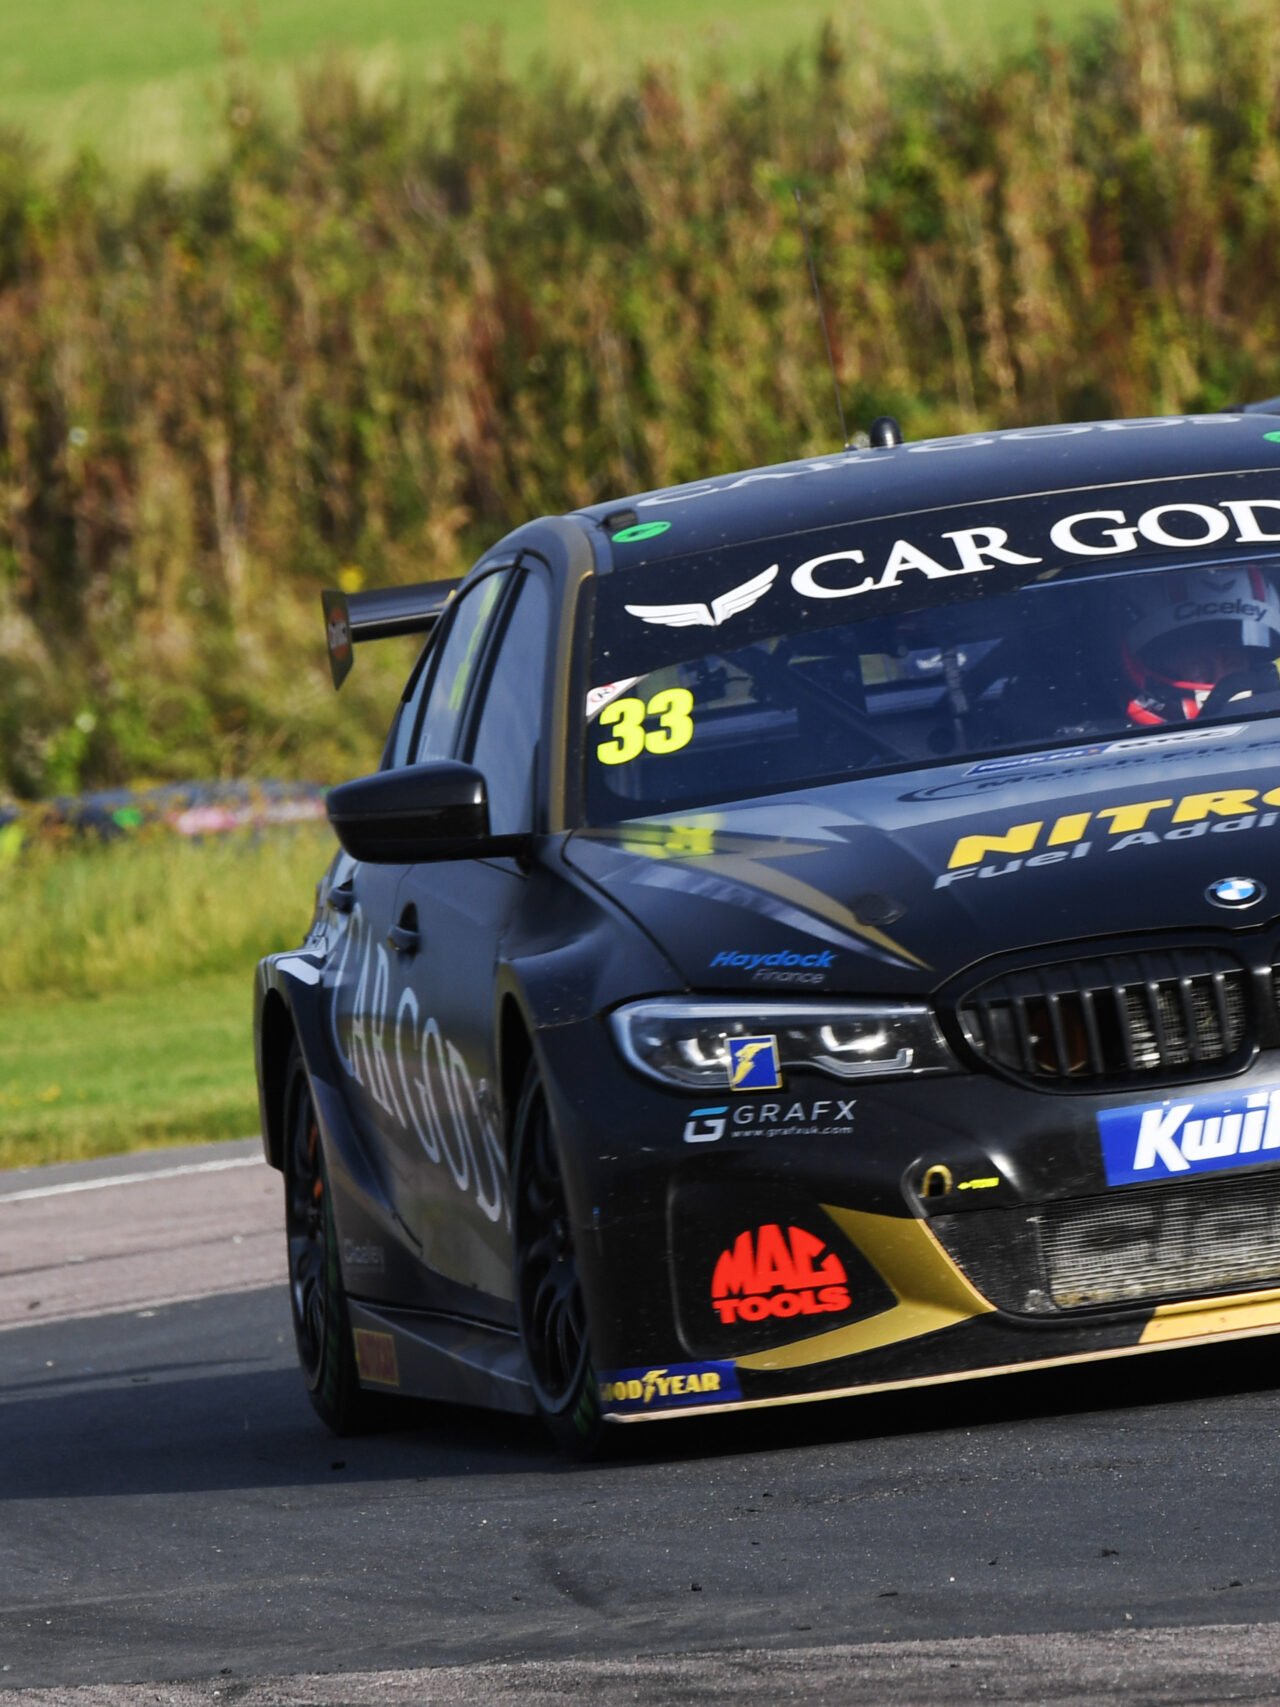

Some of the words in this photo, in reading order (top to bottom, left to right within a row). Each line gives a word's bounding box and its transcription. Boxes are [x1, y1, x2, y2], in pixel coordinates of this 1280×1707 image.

[790, 526, 1043, 600] CAR
[596, 687, 694, 765] 33
[933, 841, 1094, 890] Fuel
[709, 949, 839, 971] Haydock
[751, 968, 825, 984] Finance
[732, 1099, 858, 1125] GRAFX
[711, 1223, 849, 1298] MAC
[712, 1285, 853, 1325] TOOLS
